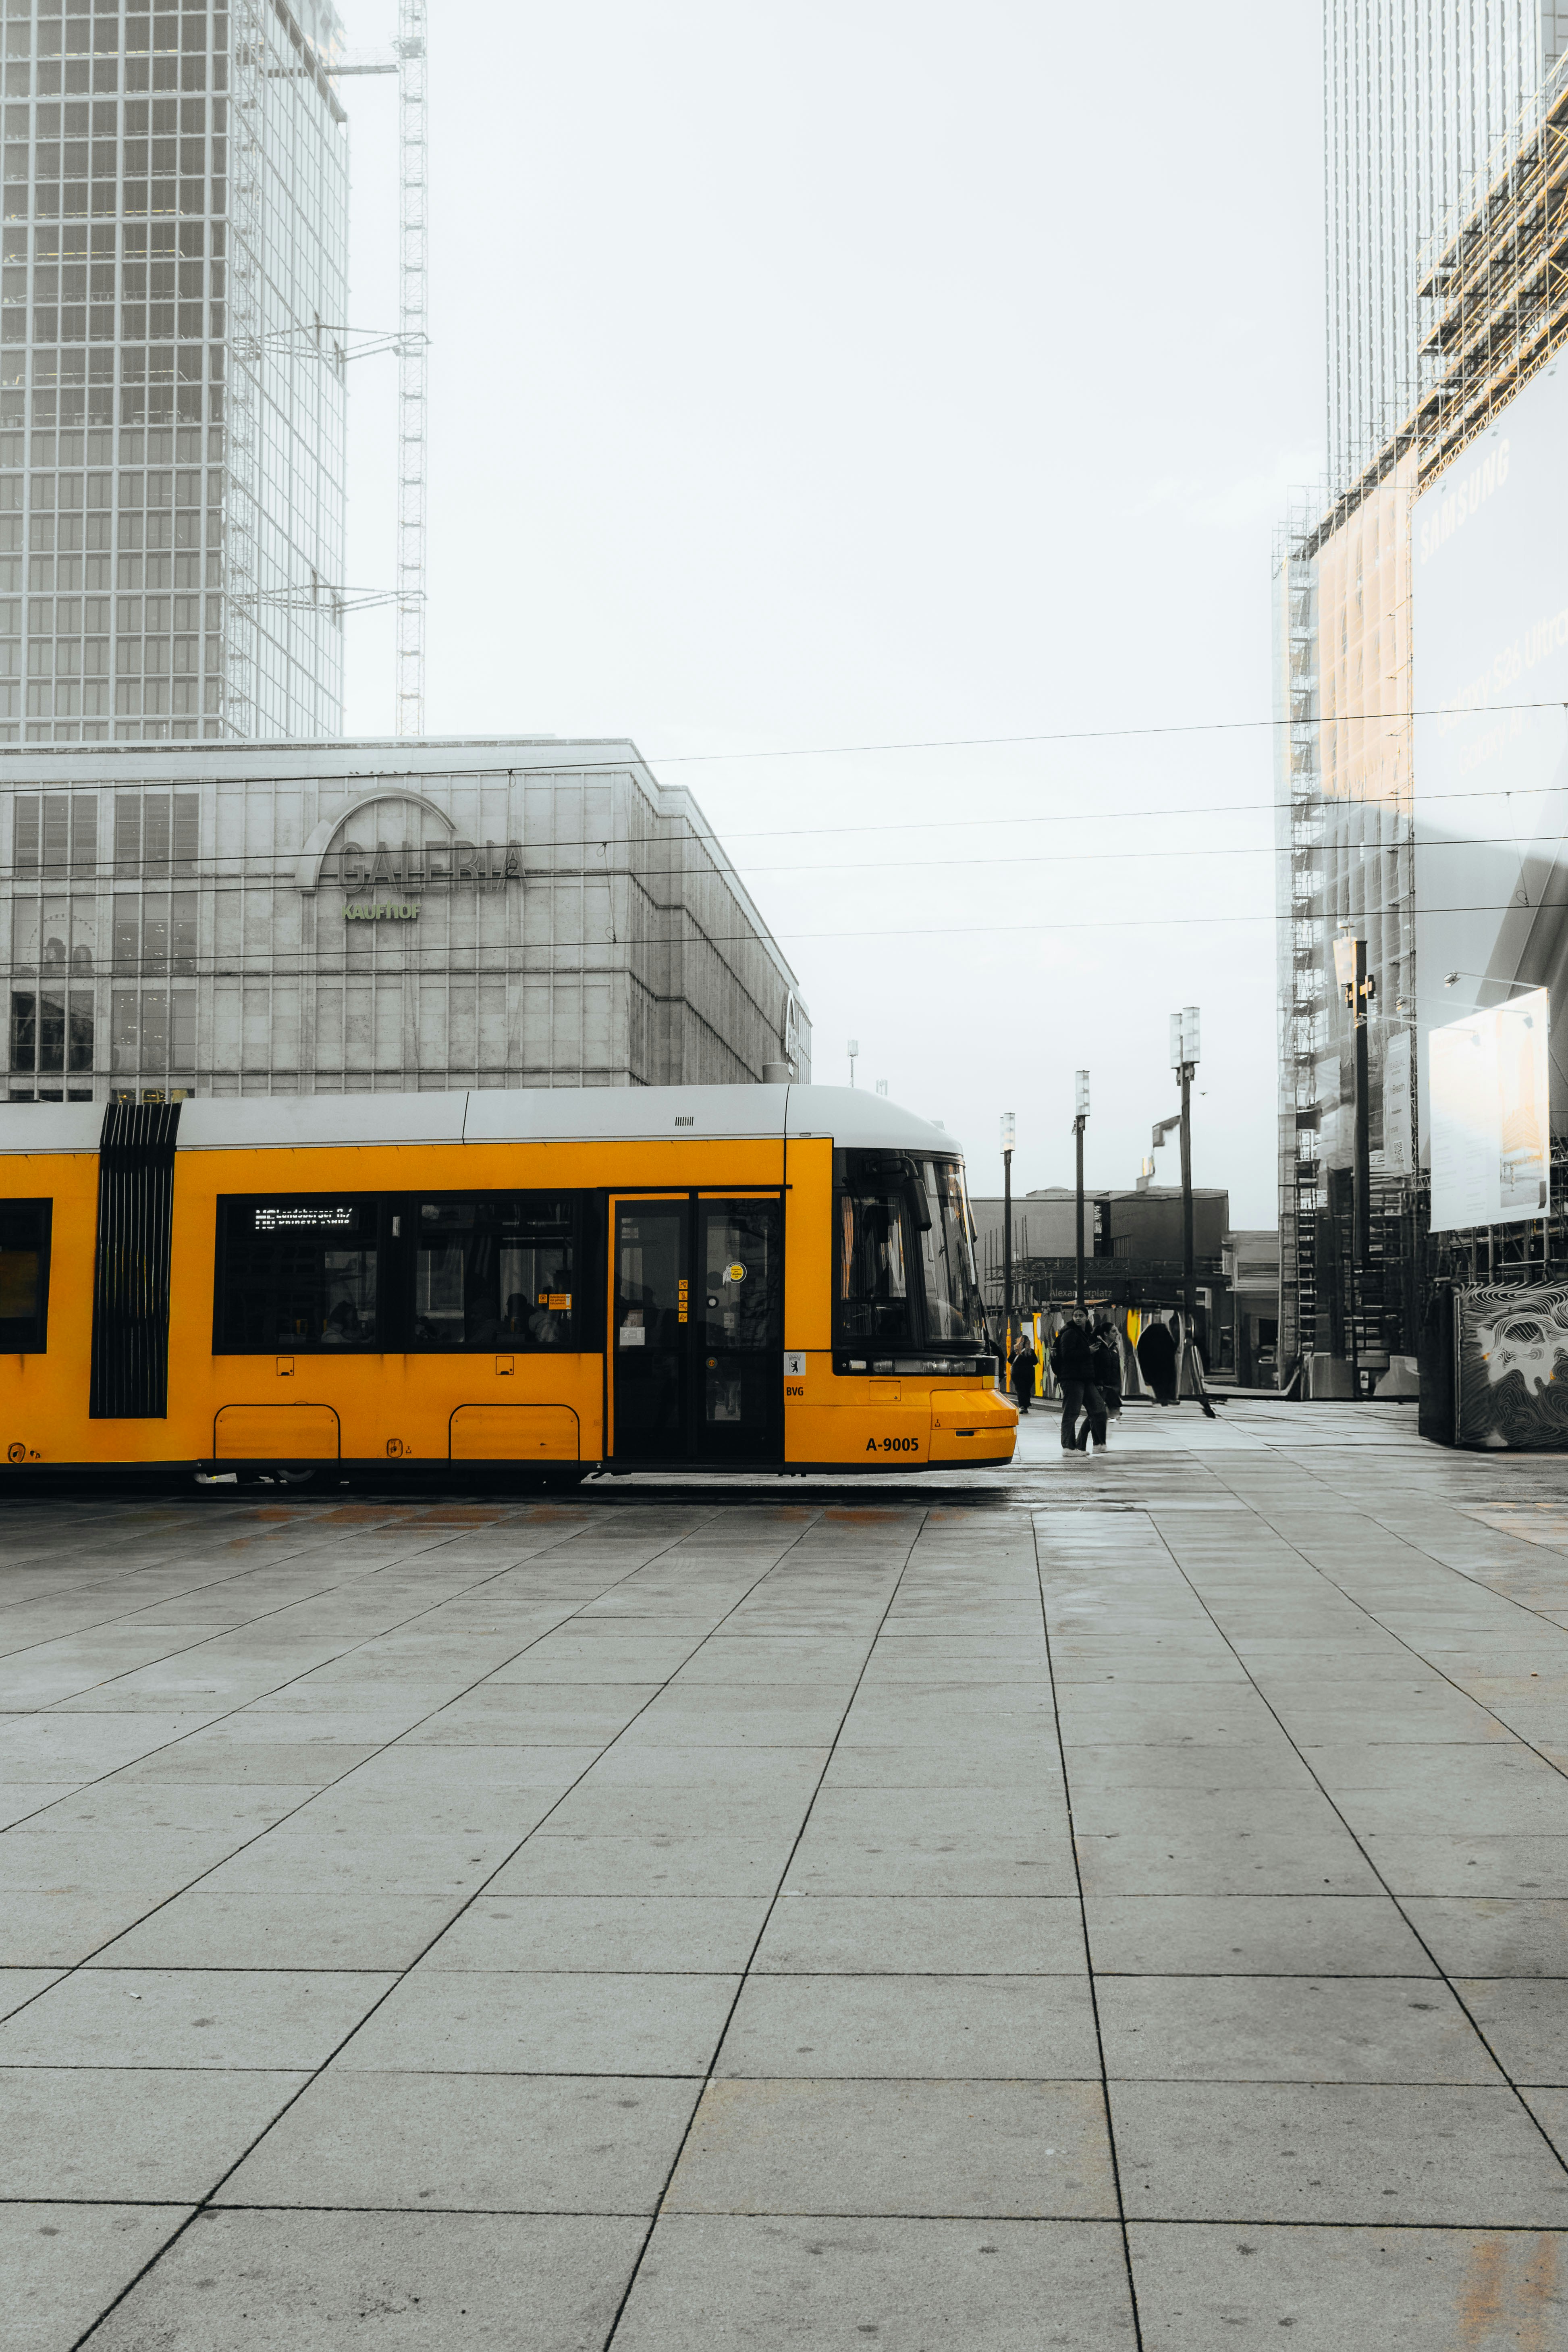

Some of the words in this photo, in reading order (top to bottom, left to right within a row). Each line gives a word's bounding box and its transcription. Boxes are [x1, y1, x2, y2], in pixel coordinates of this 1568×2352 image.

[1420, 438, 1511, 565] SAMSUNG
[338, 839, 529, 893] GALERIA
[1049, 1288, 1112, 1298] Alexanerplatz
[786, 1387, 804, 1396] BVG
[866, 1438, 919, 1451] A-9005
